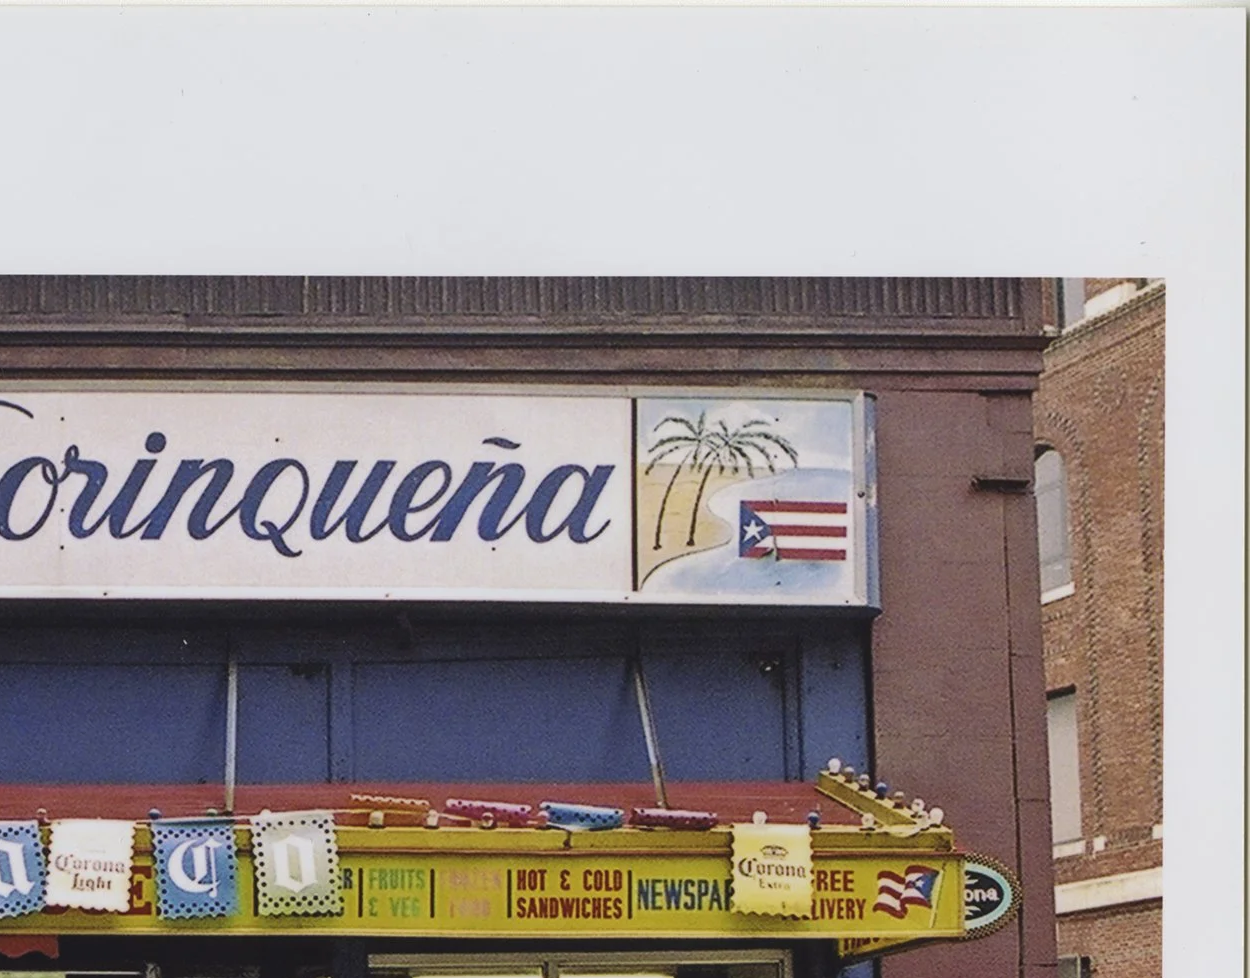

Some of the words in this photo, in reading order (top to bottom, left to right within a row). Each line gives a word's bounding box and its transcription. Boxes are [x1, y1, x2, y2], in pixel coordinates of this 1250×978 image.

[54, 854, 125, 874] Corona
[738, 857, 805, 878] Corona
[71, 874, 112, 891] Light
[369, 868, 425, 890] FRUITS
[517, 869, 547, 891] HOT
[583, 869, 623, 891] COLD
[811, 870, 854, 892] REE
[390, 897, 421, 918] VEG
[517, 897, 623, 919] SANDWICHES
[811, 898, 867, 920] LIVERY
